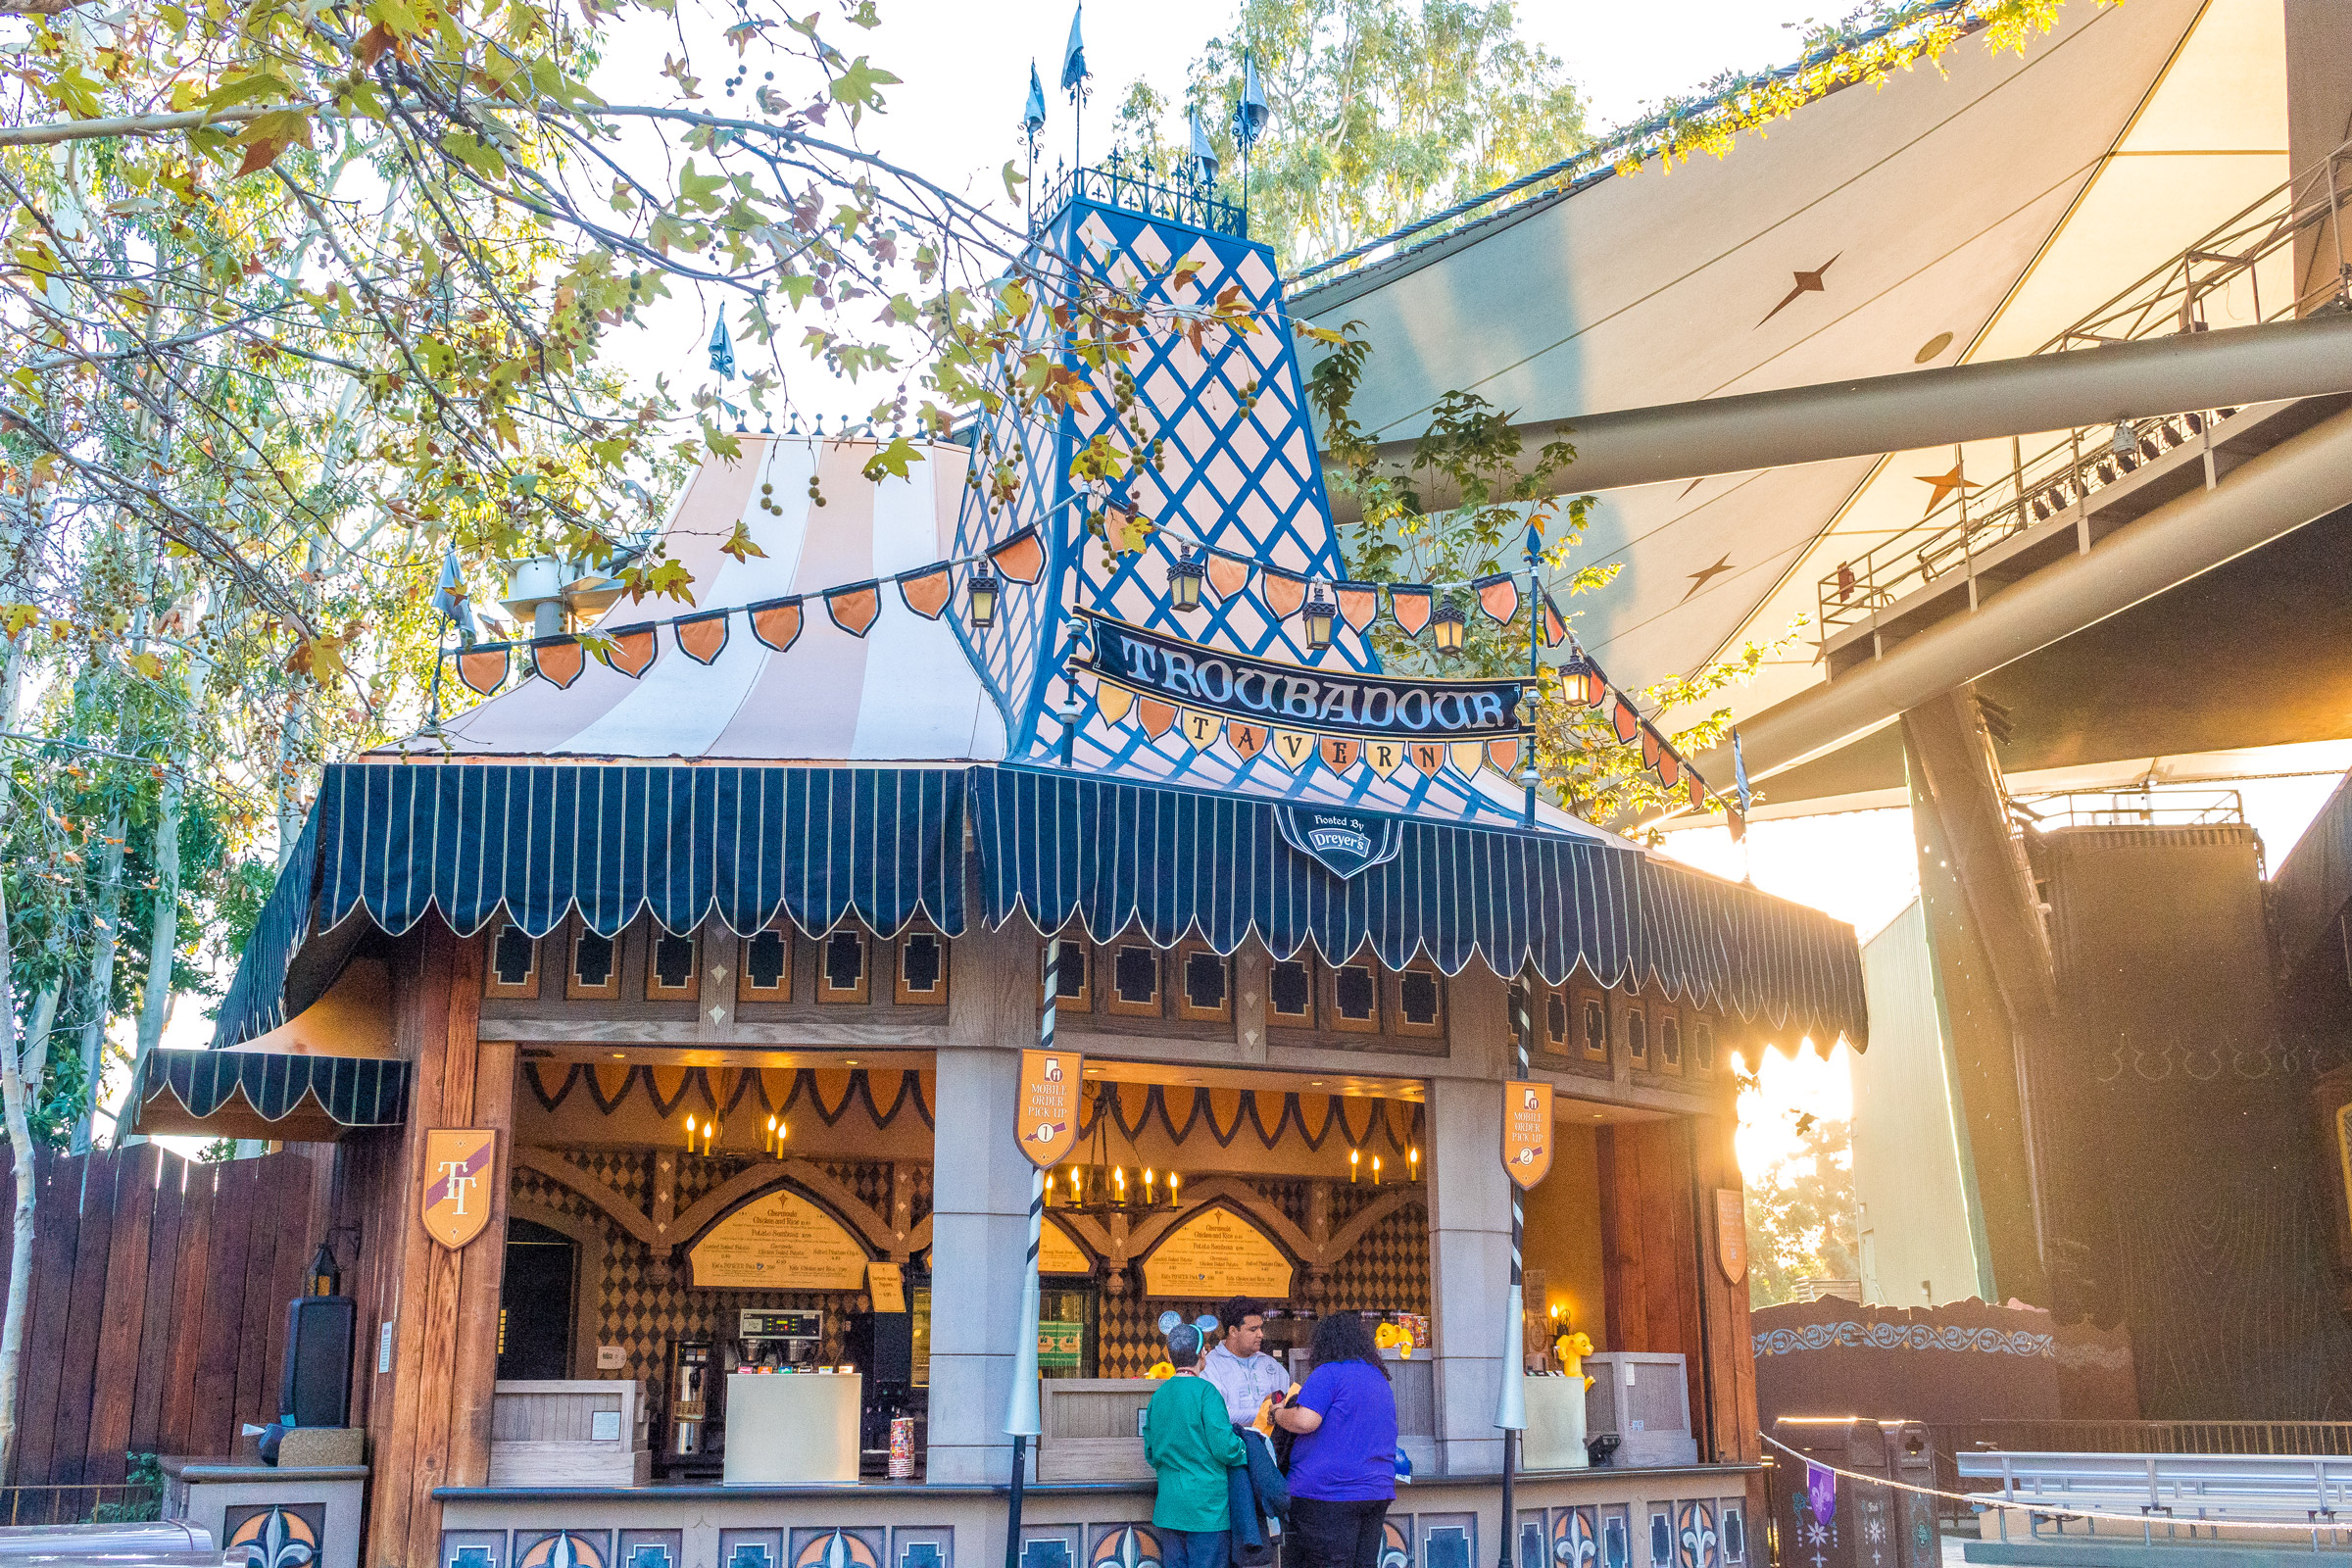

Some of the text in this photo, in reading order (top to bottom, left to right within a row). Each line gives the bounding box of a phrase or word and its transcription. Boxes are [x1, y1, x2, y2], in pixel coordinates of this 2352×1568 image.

[1120, 635, 1504, 730] TROUBADOUR
[1193, 716, 1436, 767] TAVERN
[1314, 814, 1364, 832] Hosted By
[1031, 1083, 1067, 1096] MOBILE
[1032, 1096, 1064, 1106] ORDER
[1028, 1106, 1067, 1118] PICK UP
[1513, 1111, 1543, 1122] MOBILE
[1043, 1126, 1049, 1141] 1
[1514, 1122, 1541, 1133] ORDER
[1511, 1133, 1544, 1144] PICK UP
[1522, 1150, 1531, 1163] 2
